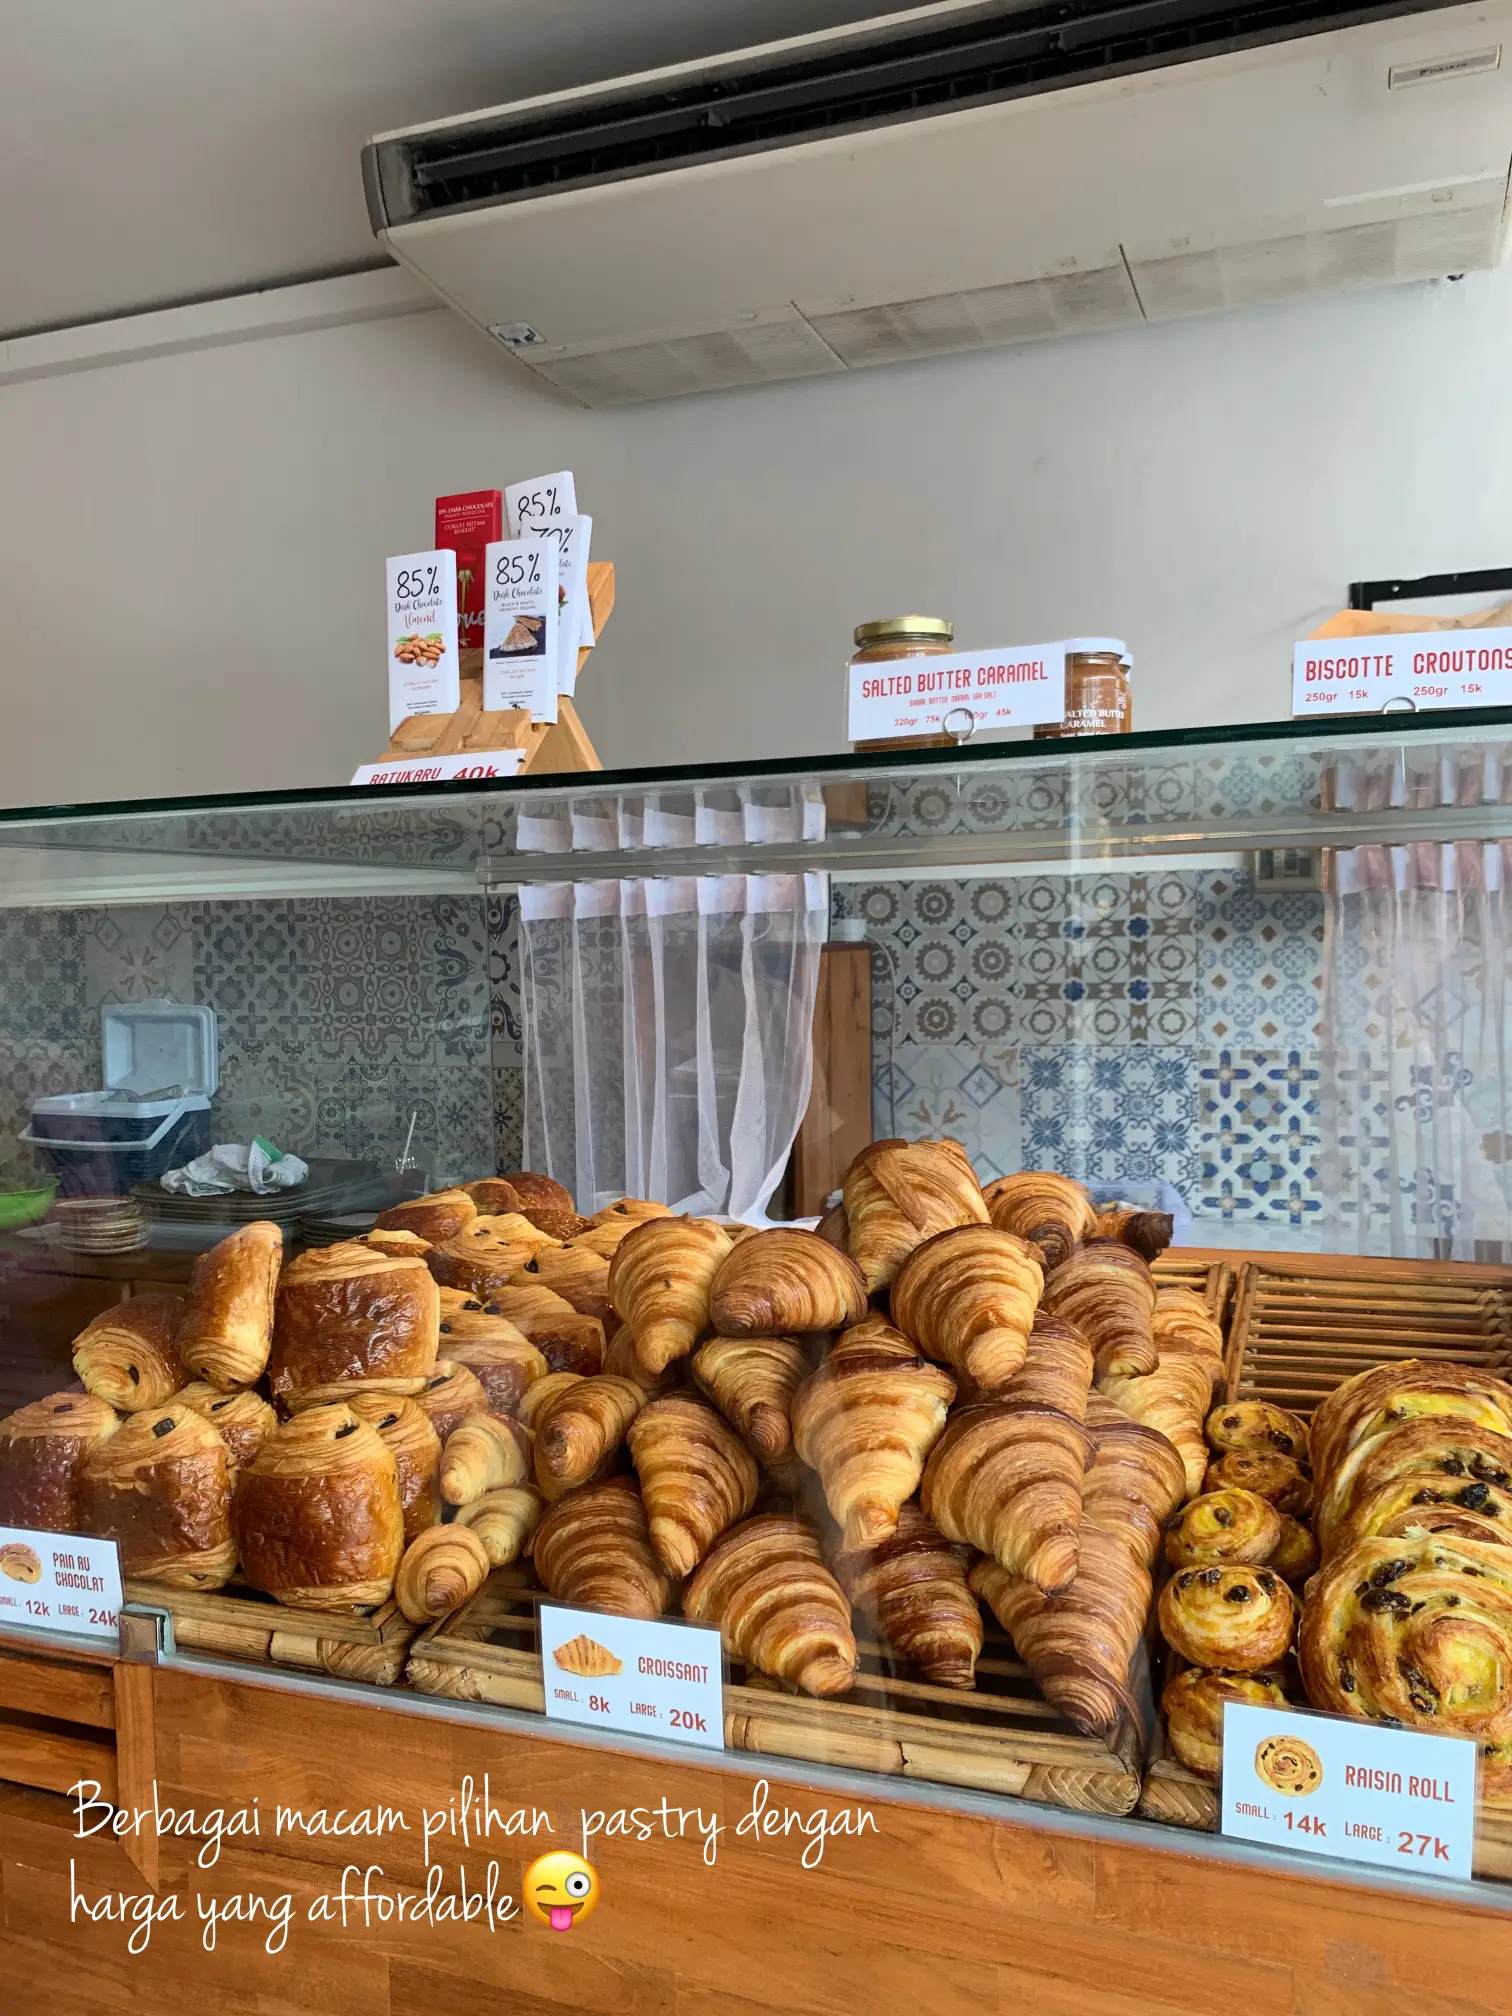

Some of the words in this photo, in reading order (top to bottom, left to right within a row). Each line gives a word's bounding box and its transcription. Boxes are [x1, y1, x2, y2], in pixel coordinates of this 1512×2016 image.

[396, 566, 440, 598] 85%
[496, 552, 540, 585] 85%
[394, 600, 411, 613] Dark
[412, 598, 443, 610] Chocolate
[492, 590, 510, 601] Dark
[512, 586, 543, 598] Chocolate
[1306, 654, 1394, 682] BISCOTTE
[1413, 648, 1512, 674] CROUTONS
[862, 676, 912, 698] SALTED
[918, 669, 972, 692] BUTTER
[977, 661, 1048, 686] CARAMEL
[1306, 692, 1338, 703] 250gr
[1349, 690, 1368, 699] 15k
[1413, 686, 1448, 697] 250gr
[1460, 684, 1482, 693] 15k
[894, 718, 918, 727] 320gr
[926, 716, 940, 724] 75k
[996, 708, 1012, 716] 45k
[452, 765, 500, 779] 40k
[52, 1552, 75, 1570] PAIN
[78, 1556, 90, 1572] AU
[55, 1572, 104, 1592] CHOCOLAT
[26, 1600, 50, 1616] 12k
[58, 1604, 80, 1617] LARGE
[88, 1608, 118, 1628] 24k
[638, 1656, 708, 1684] CROISSANT
[554, 1688, 578, 1702] SMALL
[588, 1695, 611, 1714] 8k
[630, 1702, 657, 1718] LARGE
[669, 1708, 708, 1732] 20k
[1345, 1764, 1401, 1794] RAISIN
[1408, 1776, 1454, 1803] ROLL
[1235, 1802, 1270, 1820] SMALL
[1283, 1811, 1327, 1837] 14k
[1344, 1821, 1383, 1842] LARGE
[1398, 1831, 1450, 1861] 27k
